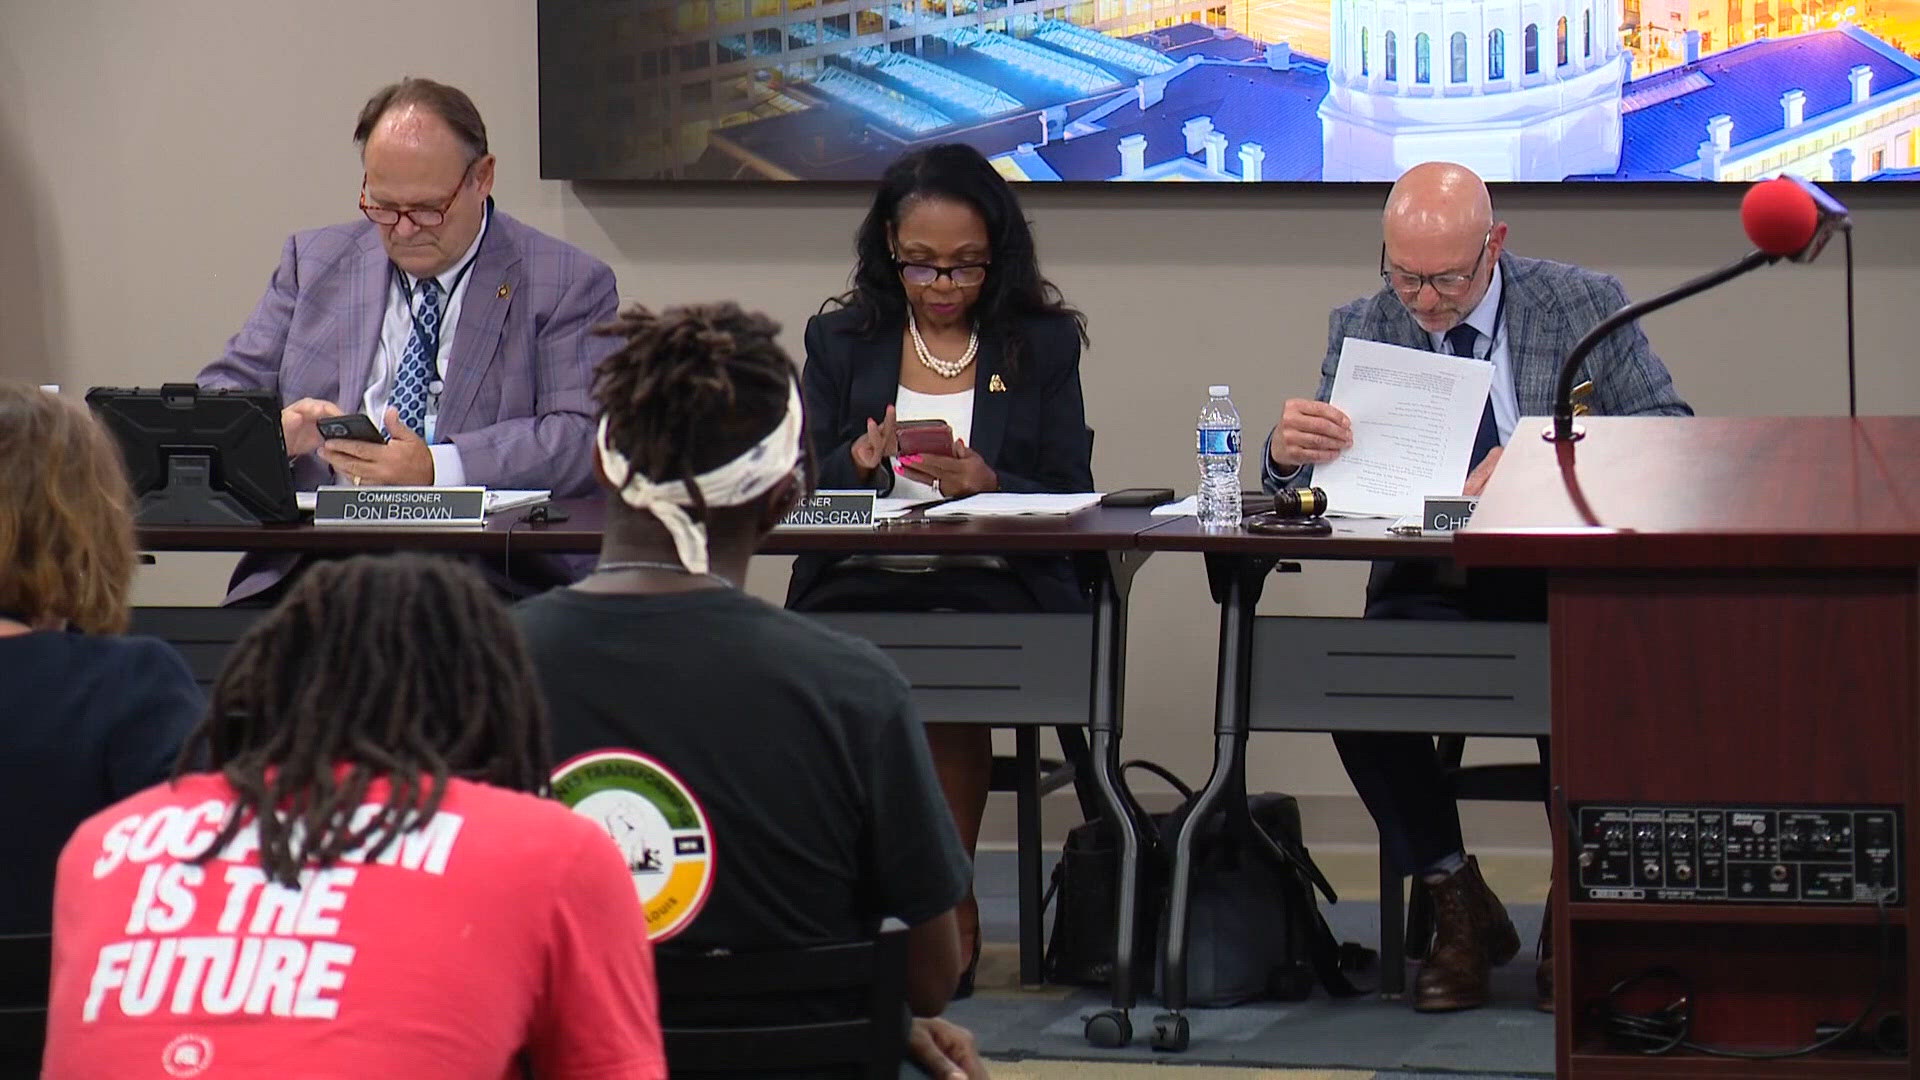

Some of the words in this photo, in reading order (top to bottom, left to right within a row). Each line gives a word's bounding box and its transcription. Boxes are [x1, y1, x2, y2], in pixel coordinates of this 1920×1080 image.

[343, 503, 382, 519] DON
[387, 503, 453, 519] BROWN
[782, 510, 871, 525] NKINS-GRAY
[93, 799, 463, 875] SOCSM
[125, 863, 204, 935] IS
[217, 866, 358, 935] THE
[82, 936, 356, 1022] FUTURE
